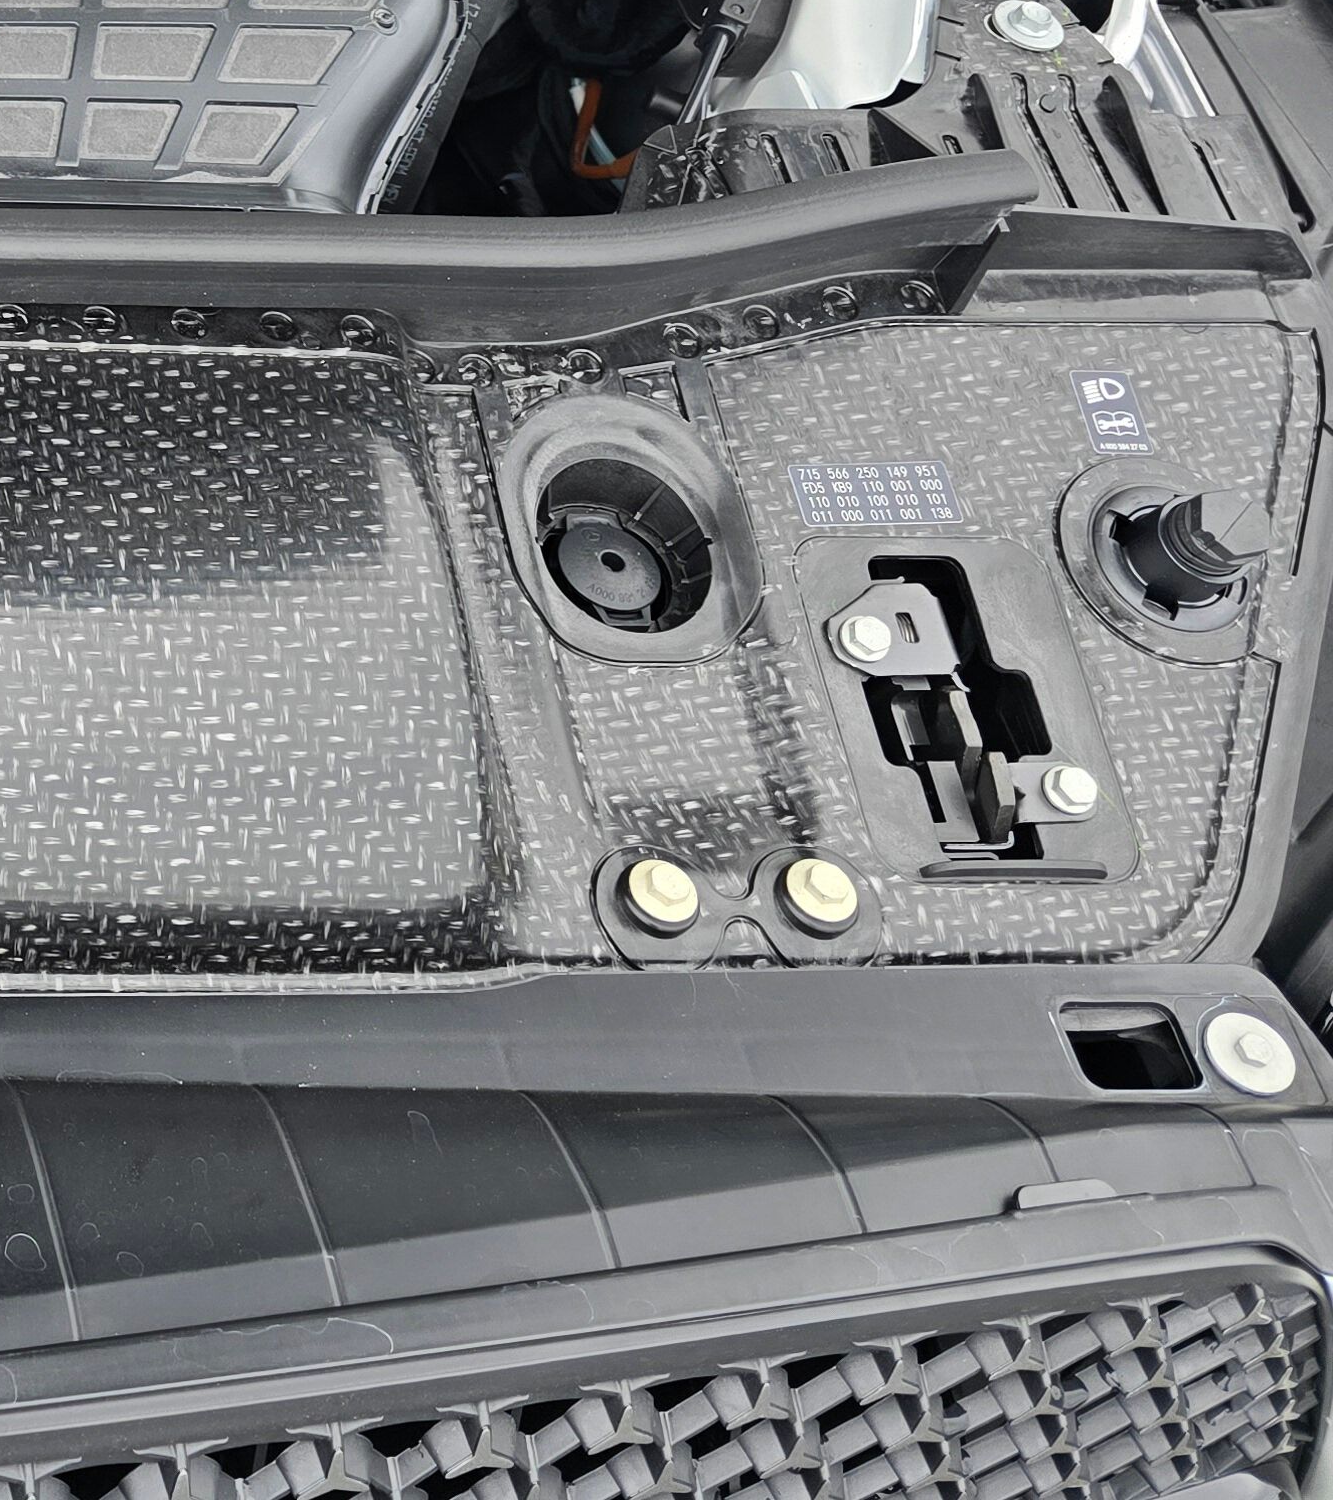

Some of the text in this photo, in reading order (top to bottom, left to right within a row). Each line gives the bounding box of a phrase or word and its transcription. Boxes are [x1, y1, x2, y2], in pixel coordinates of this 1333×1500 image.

[797, 465, 938, 480] 715 566 250 149 951
[802, 478, 943, 494] FD5 KB9 110 001 000
[808, 493, 948, 509] 110 010 100 010 101
[811, 507, 954, 523] 011 000 011 001 138
